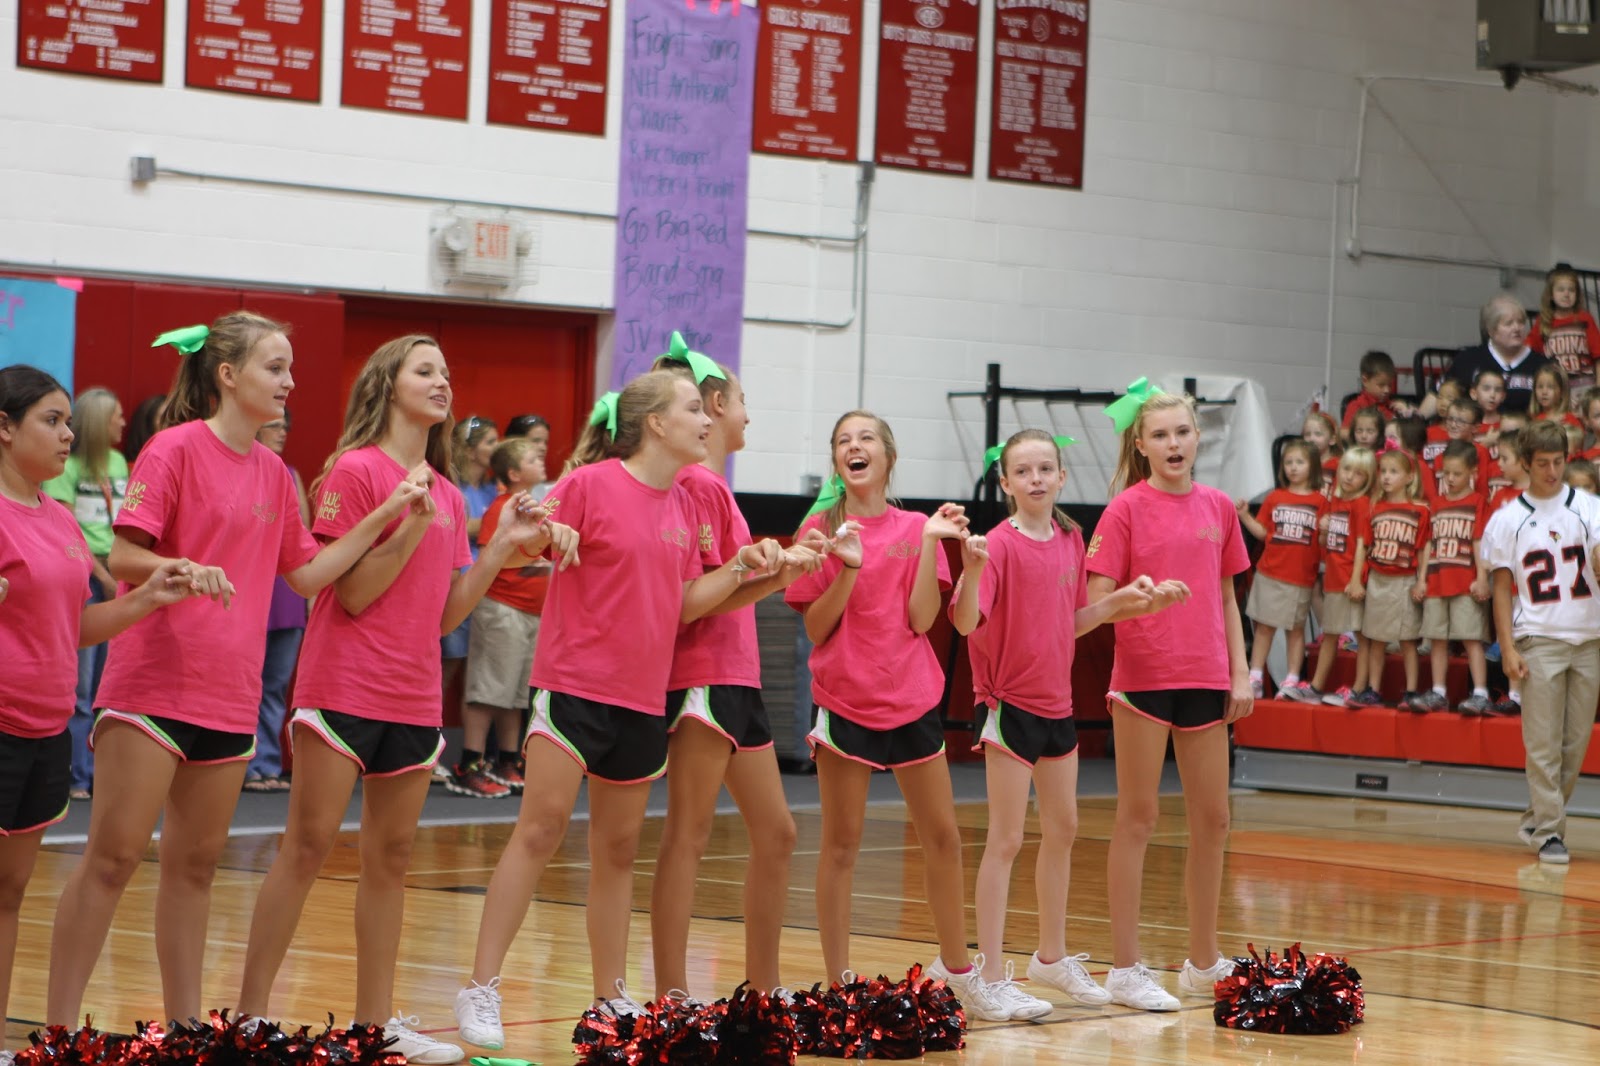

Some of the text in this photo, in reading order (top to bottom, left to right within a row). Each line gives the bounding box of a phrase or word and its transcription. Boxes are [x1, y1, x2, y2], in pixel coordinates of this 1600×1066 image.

[623, 206, 730, 253] Go Big Red
[622, 255, 681, 298] Band
[623, 319, 653, 353] JV
[1272, 508, 1318, 532] CARDINAL
[1282, 523, 1304, 539] RED
[1522, 545, 1593, 606] 27
